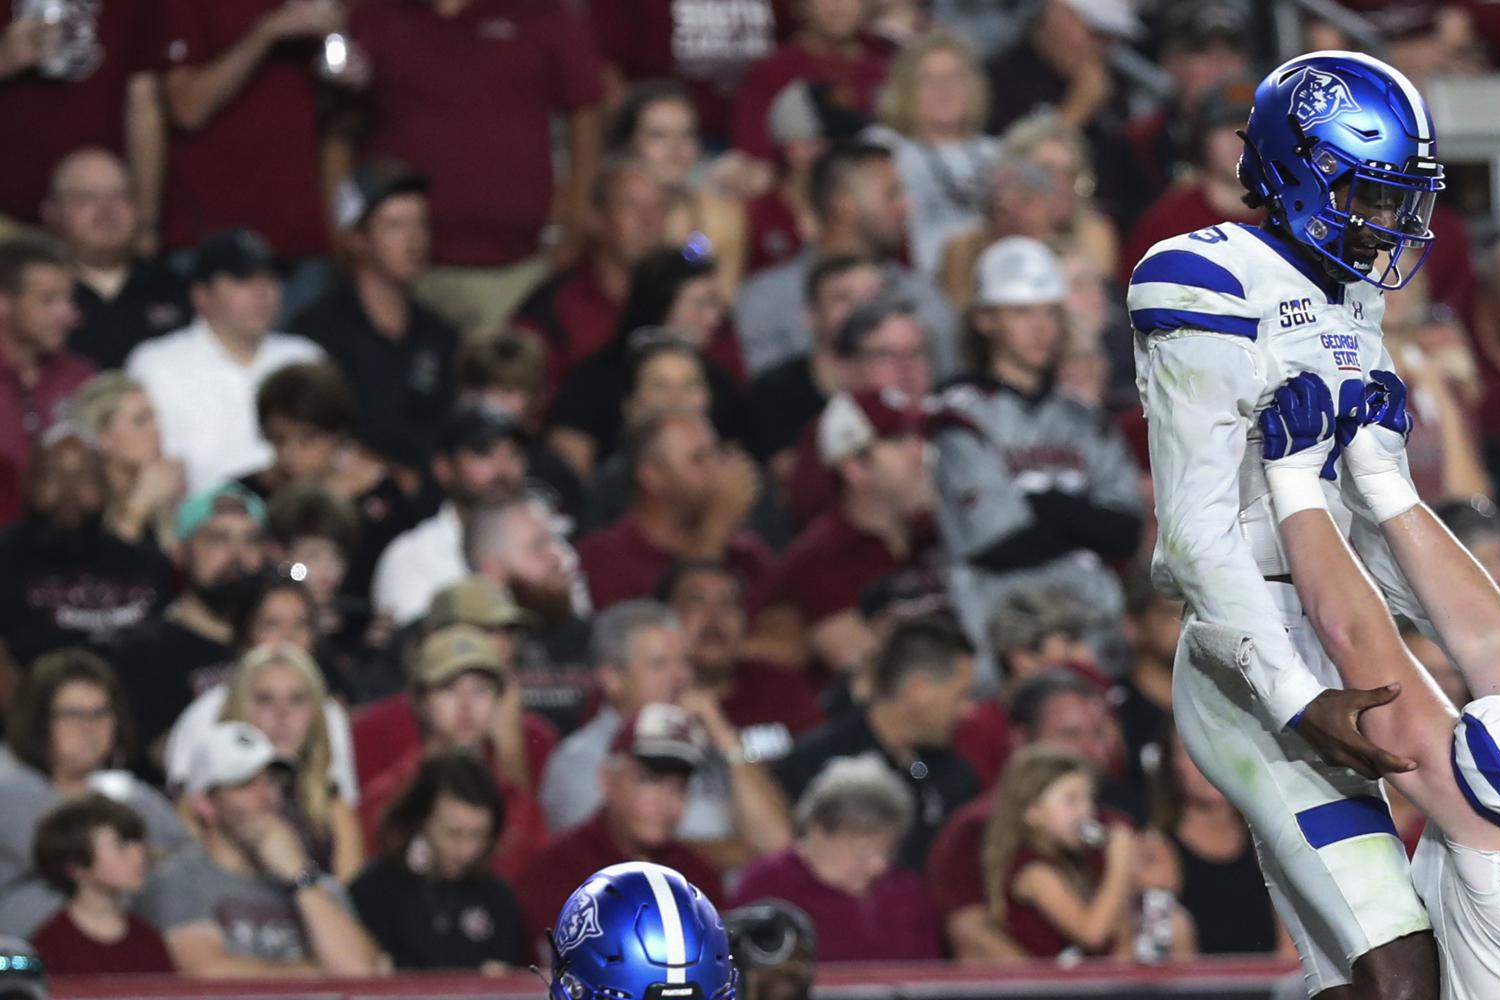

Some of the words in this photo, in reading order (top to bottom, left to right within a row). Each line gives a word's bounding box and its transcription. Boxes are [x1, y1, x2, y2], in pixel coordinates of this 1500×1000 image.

[1279, 298, 1317, 328] SBC
[1320, 334, 1360, 351] GEORGIA
[1334, 351, 1361, 368] STATE
